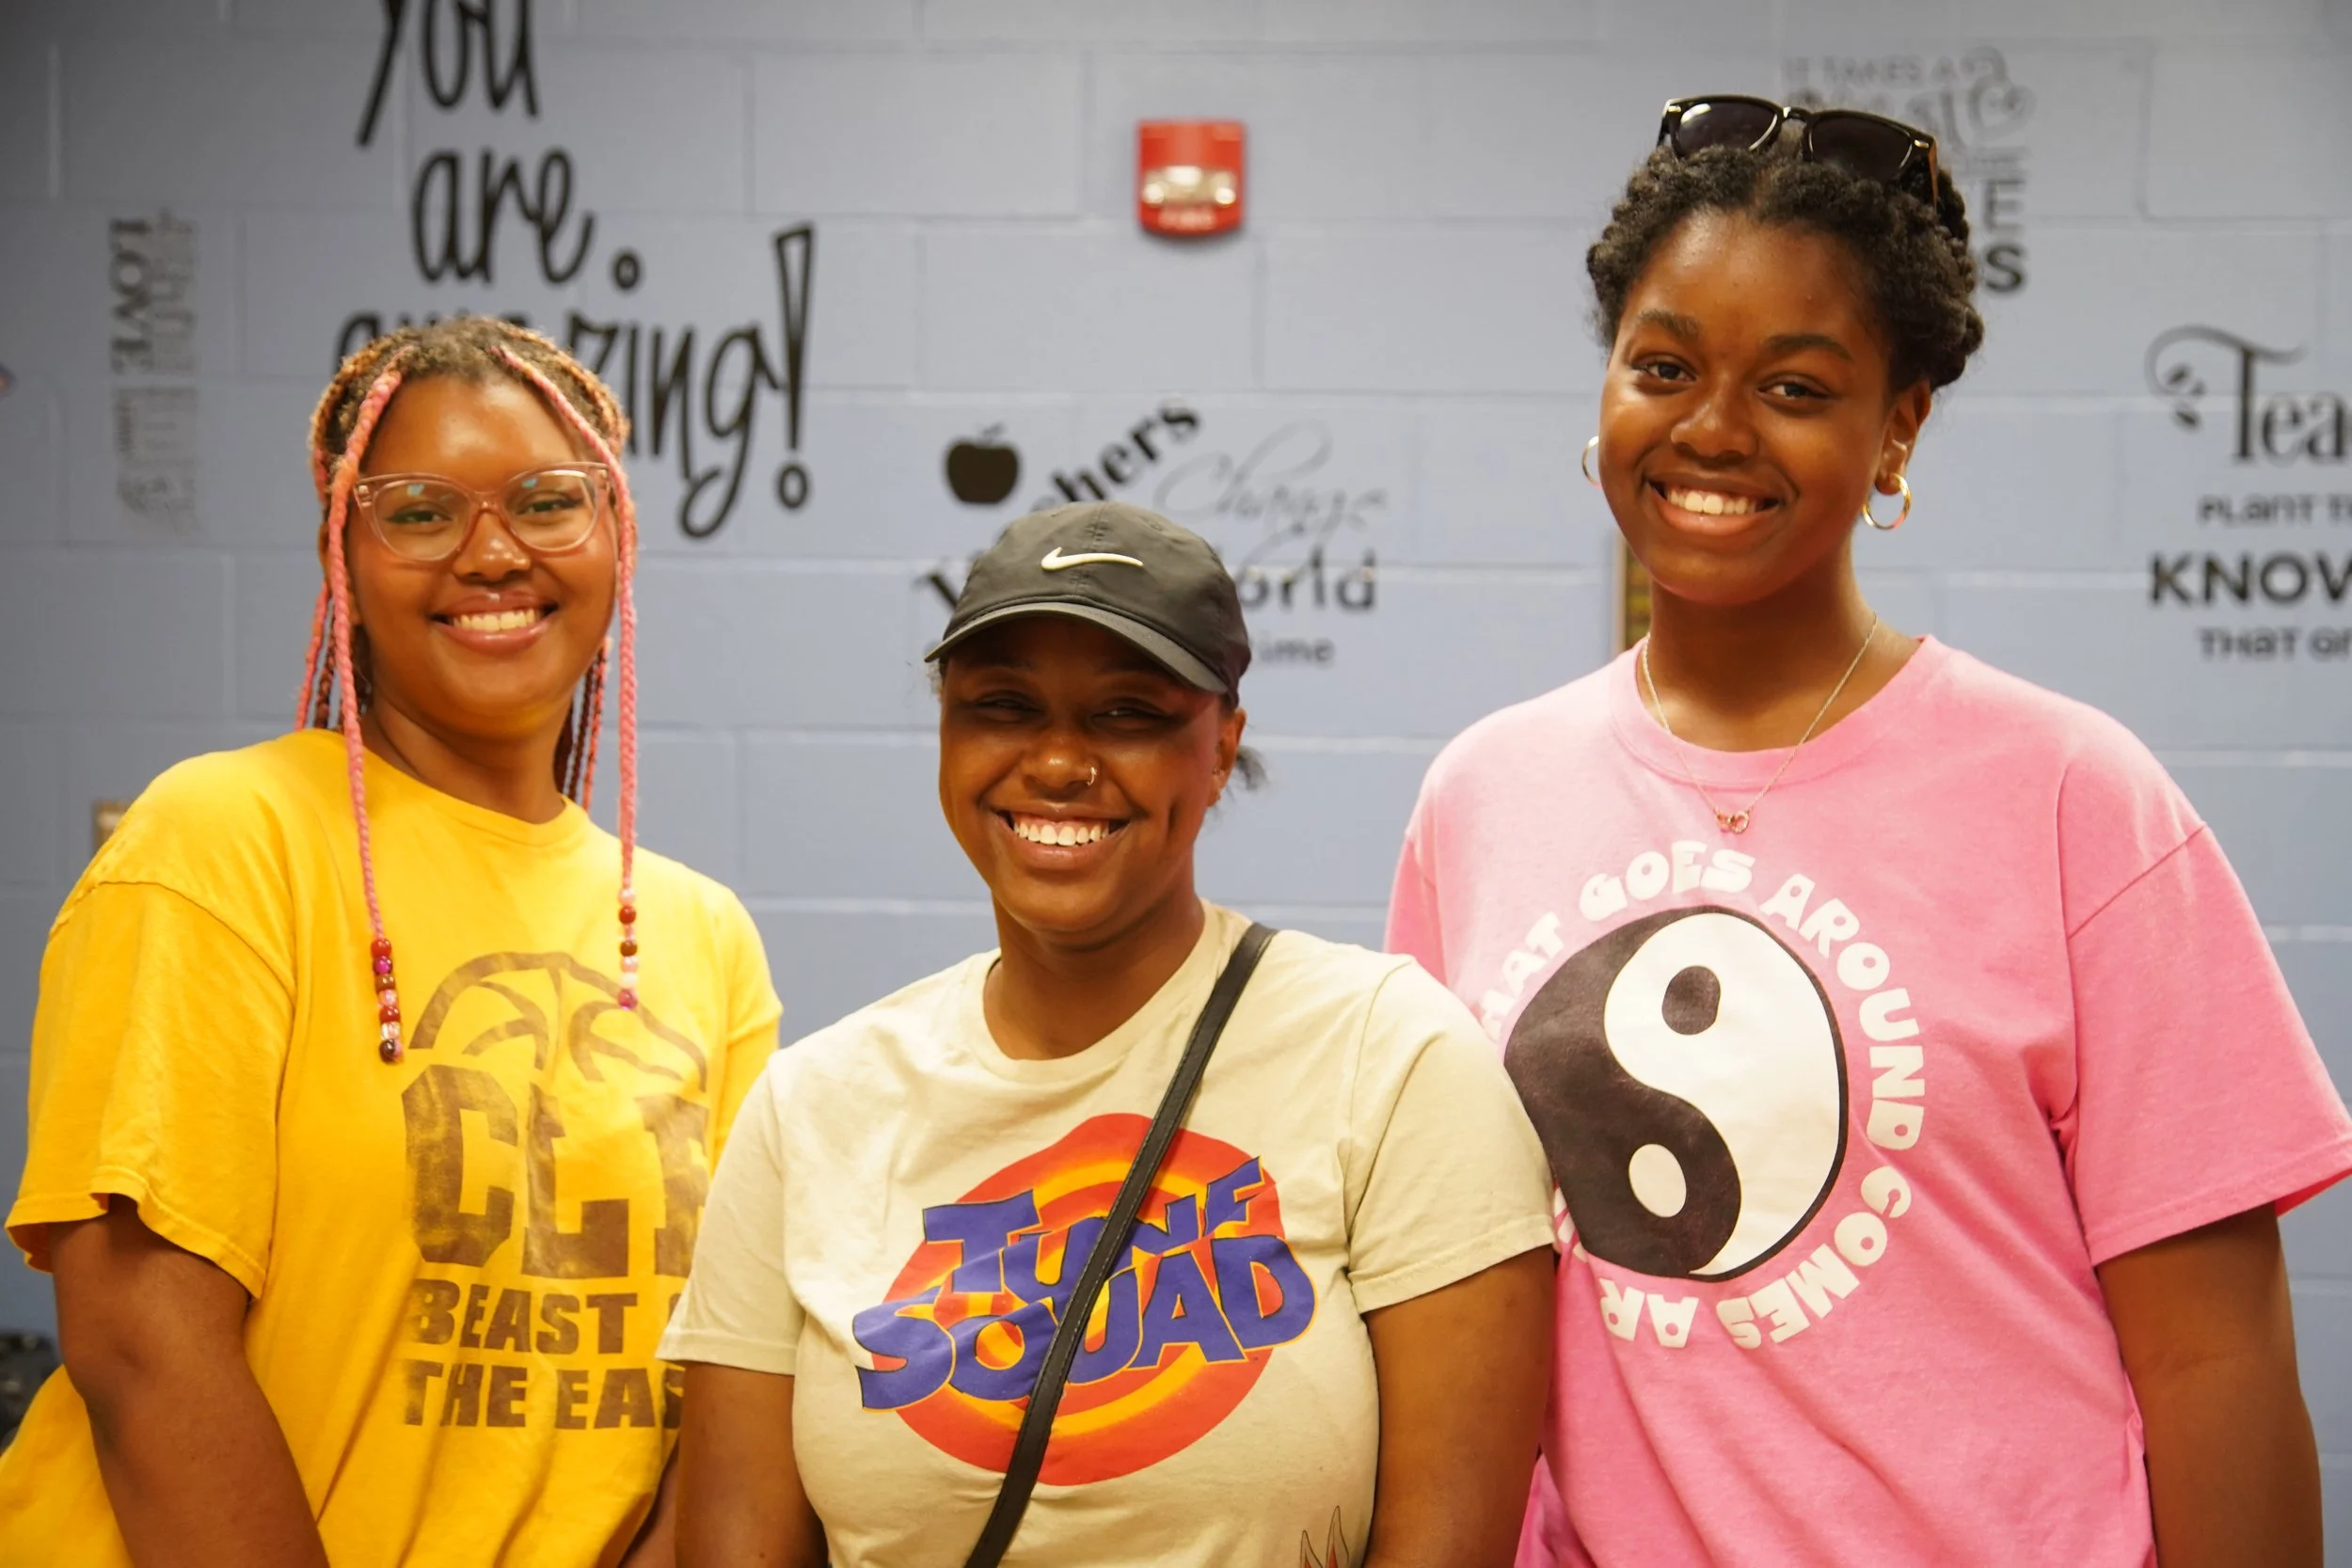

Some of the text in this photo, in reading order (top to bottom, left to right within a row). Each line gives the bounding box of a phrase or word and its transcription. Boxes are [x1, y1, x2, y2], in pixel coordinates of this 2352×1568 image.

[410, 148, 595, 286] are
[337, 224, 815, 540] zing!
[1033, 399, 1201, 514] hers
[1234, 544, 1377, 613] orld
[1253, 628, 1336, 669] ime
[1579, 840, 1756, 923] GOES
[1477, 911, 1565, 1045] HAT
[1760, 873, 1926, 1151] AROUND
[922, 1154, 1265, 1303] TUNE
[1715, 1165, 1913, 1350] COMES
[411, 1277, 638, 1355] BEAST
[851, 1233, 1319, 1411] SQUAD
[403, 1357, 529, 1428] THE
